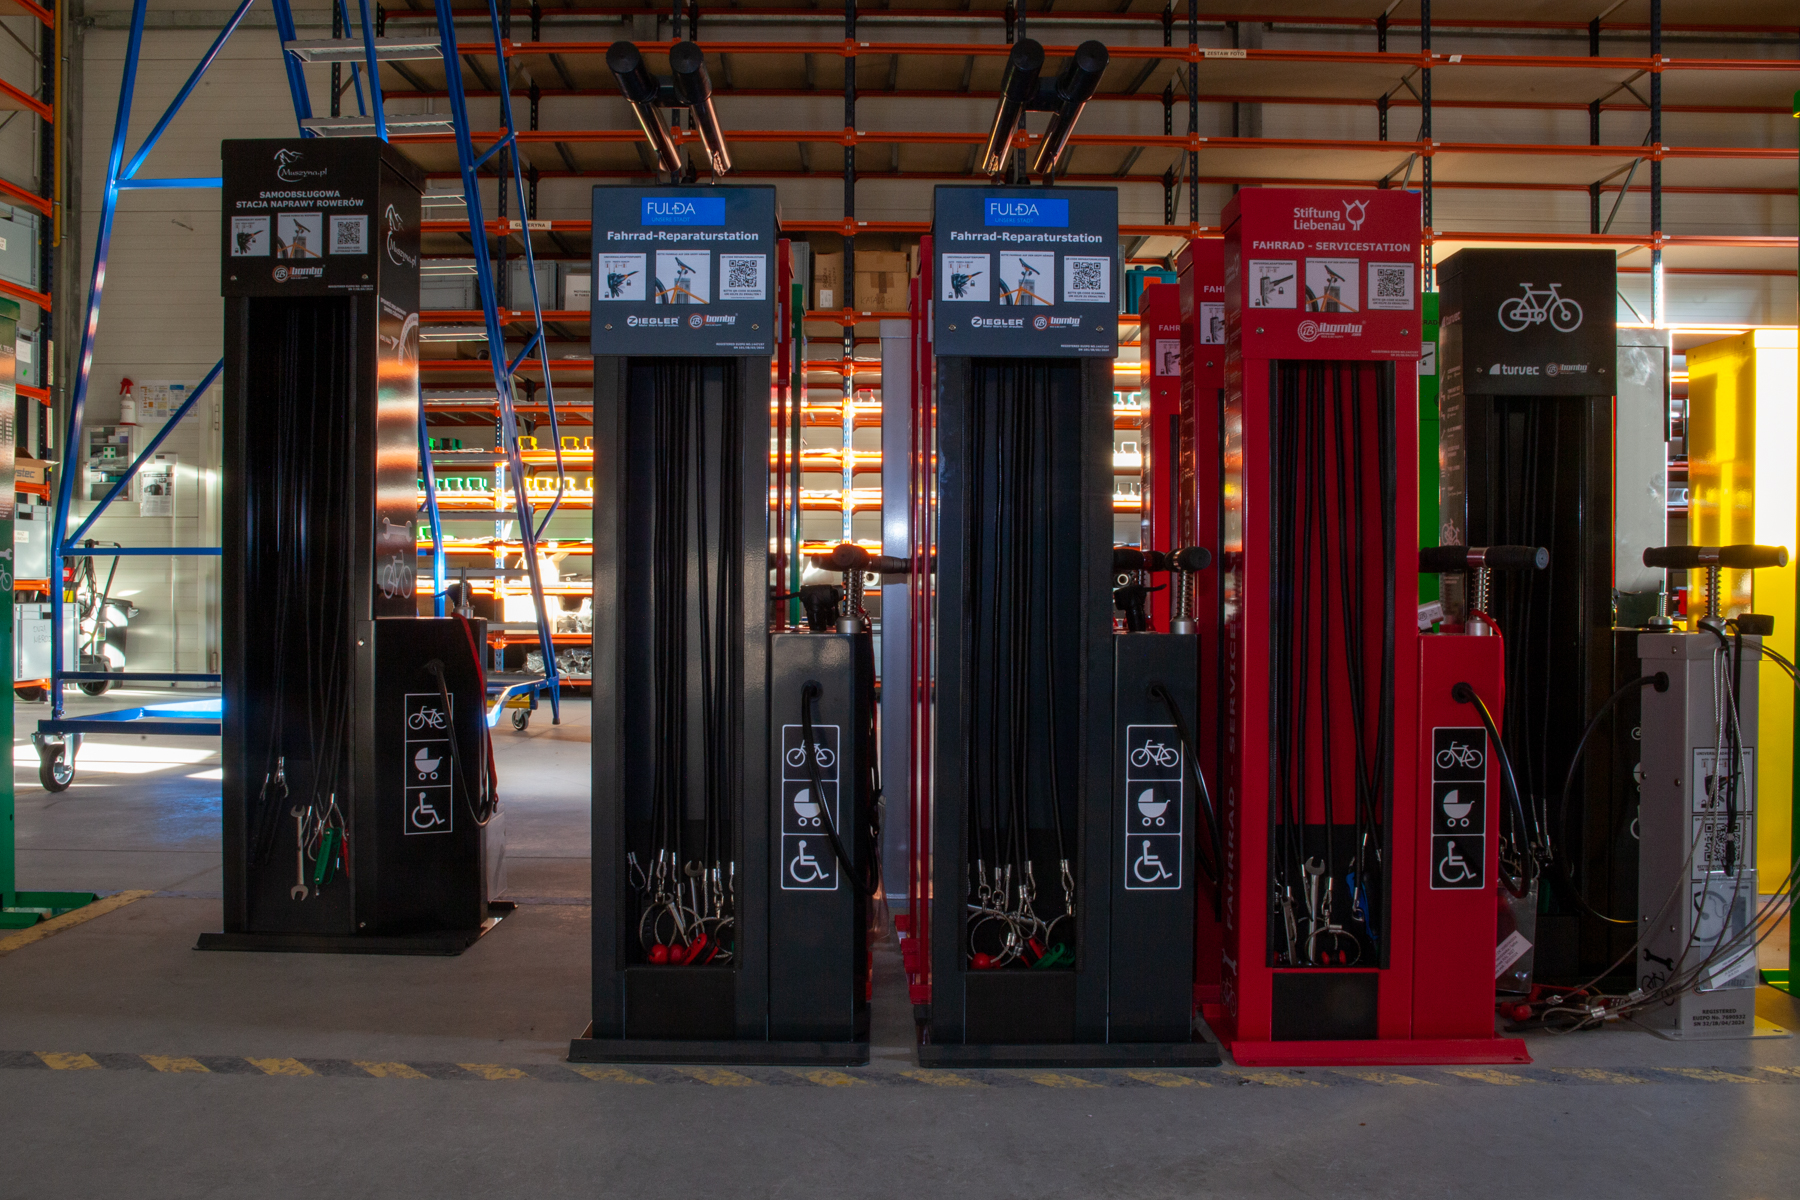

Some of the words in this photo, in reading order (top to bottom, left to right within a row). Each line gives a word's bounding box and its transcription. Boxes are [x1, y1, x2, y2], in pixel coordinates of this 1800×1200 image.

[282, 167, 328, 178] Muszyna.pl
[260, 190, 340, 199] SAMOOBSŁUGOWA
[236, 200, 268, 208] STACJA
[270, 200, 314, 208] NAPRAWY
[316, 198, 364, 207] ROWERÓW
[647, 202, 696, 214] FULDA
[990, 203, 1039, 216] FULDA
[1294, 207, 1340, 221] Stiftung
[1294, 220, 1346, 230] Liebenau
[607, 231, 759, 242] Fahrrad-Reparaturstation
[950, 231, 1102, 243] Fahrrad-Reparaturstation
[1253, 241, 1304, 250] FAHRRAD
[1316, 242, 1411, 252] SERVICESTATION
[627, 315, 678, 327] ZIEGLER
[971, 316, 1023, 328] ZIEGLER
[1319, 322, 1362, 333] ibombo
[1502, 364, 1540, 375] turvec
[1226, 786, 1236, 932] FAHRRAD
